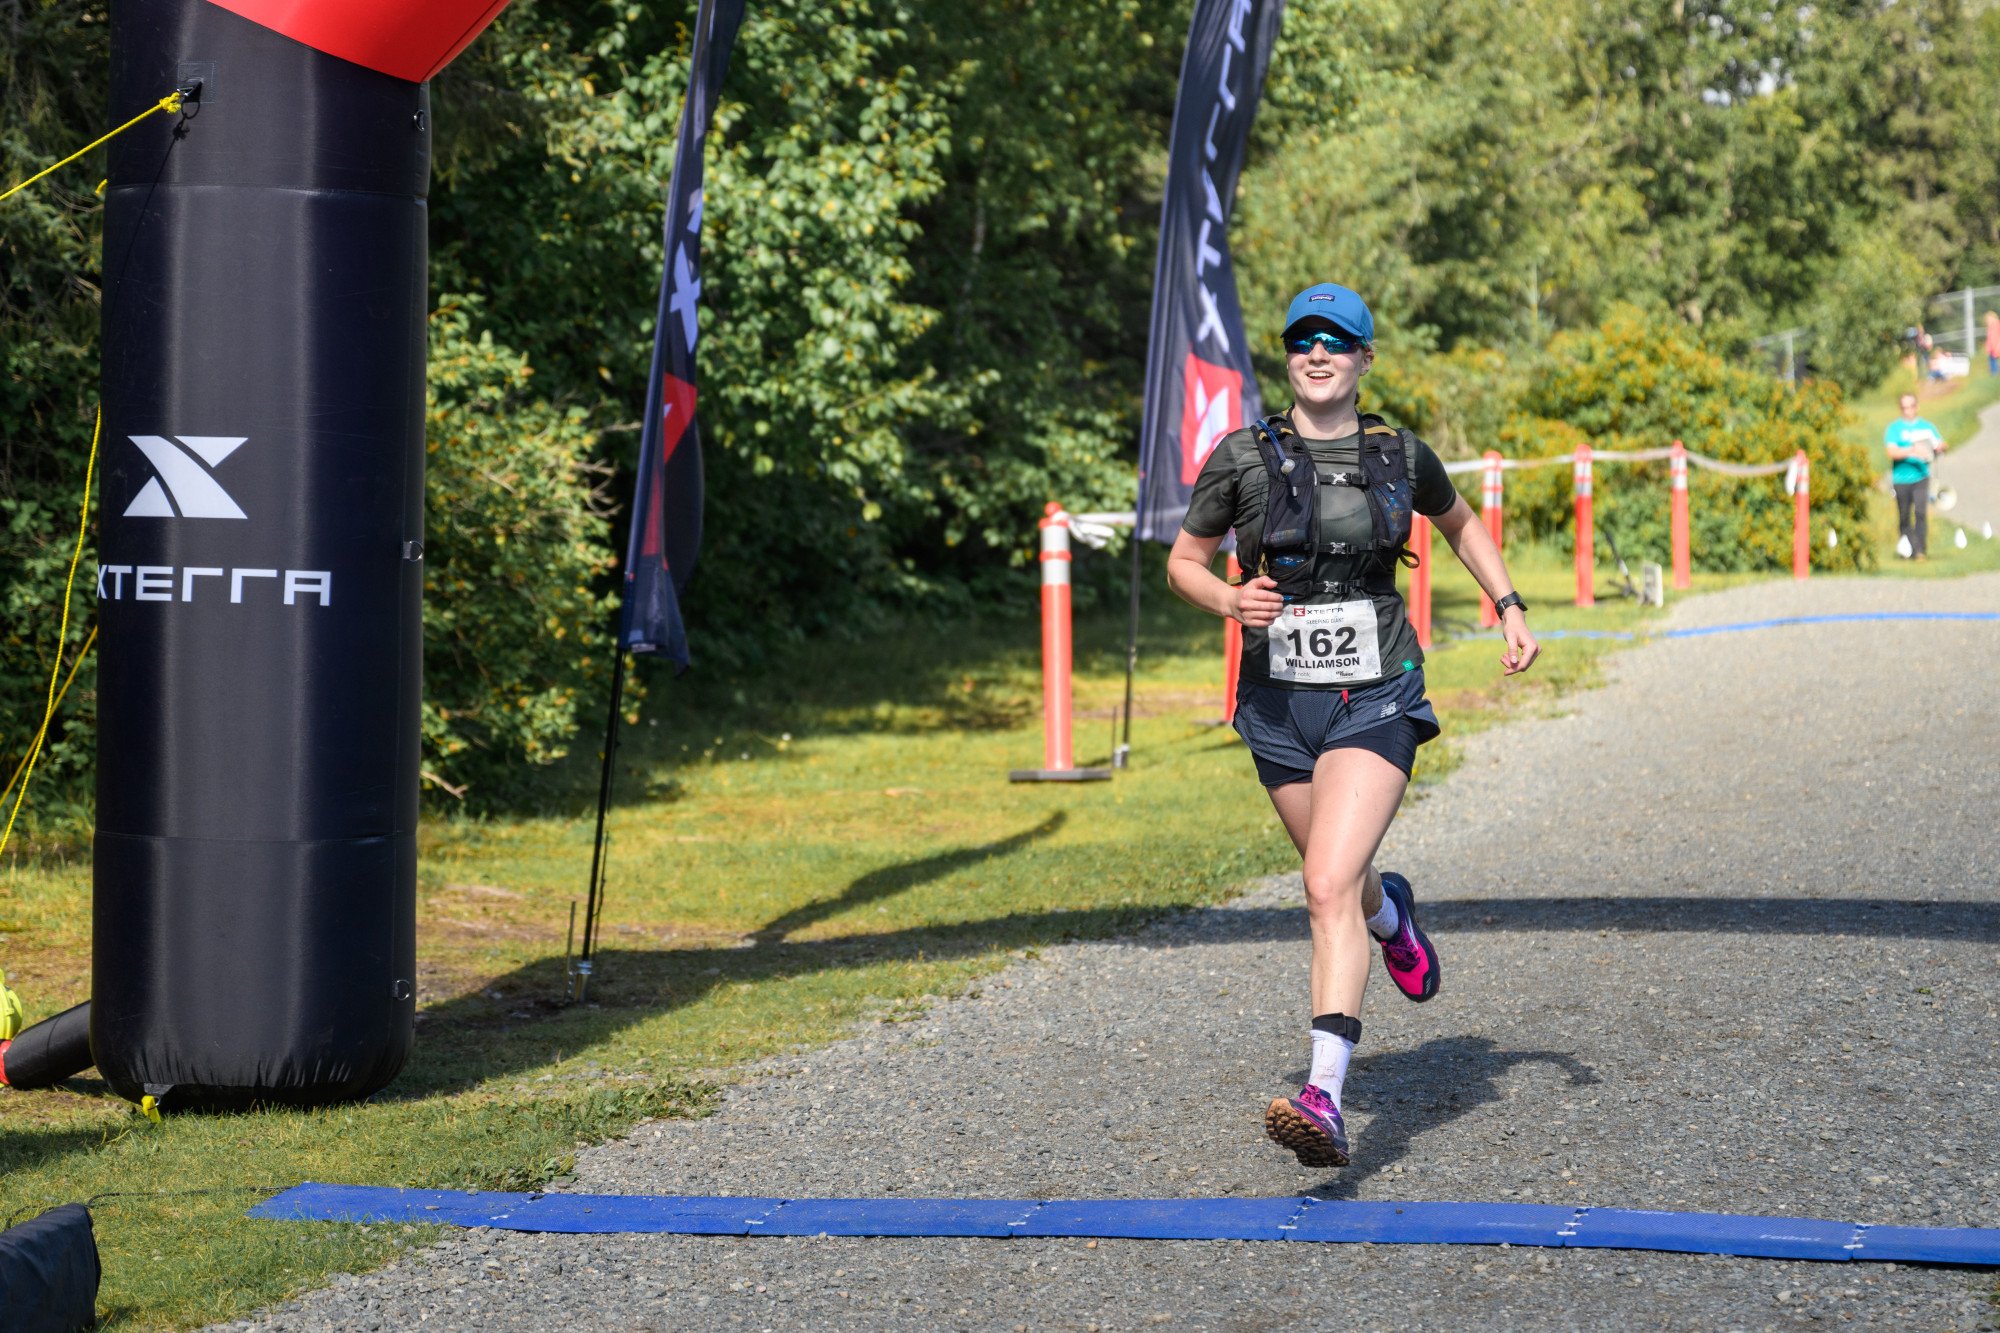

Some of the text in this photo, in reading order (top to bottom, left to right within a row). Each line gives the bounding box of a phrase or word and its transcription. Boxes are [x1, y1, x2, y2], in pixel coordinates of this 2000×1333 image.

[97, 564, 332, 607] XTERRA
[1287, 627, 1356, 656] 162
[1286, 657, 1359, 669] WILLIAMSON
